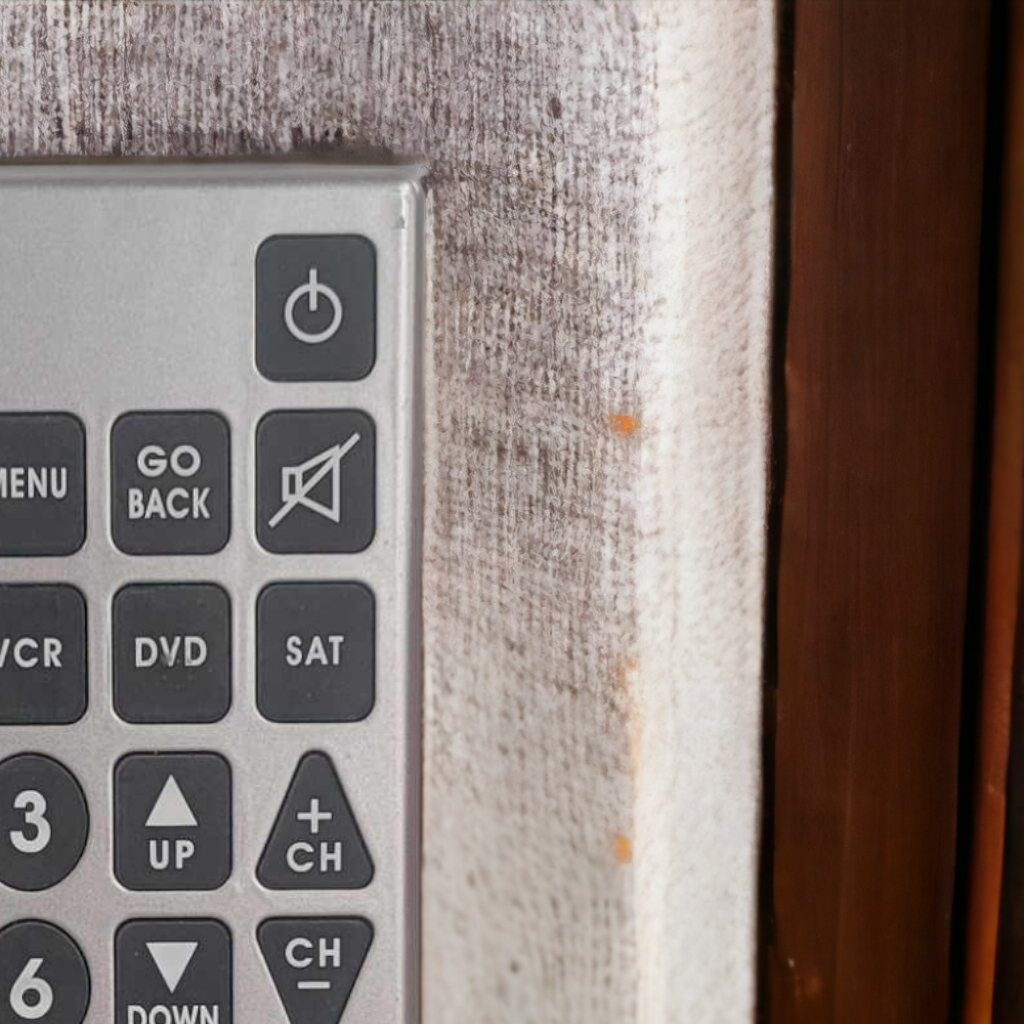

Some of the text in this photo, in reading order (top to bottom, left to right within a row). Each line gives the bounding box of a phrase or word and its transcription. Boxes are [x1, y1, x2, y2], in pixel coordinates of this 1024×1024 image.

[138, 446, 200, 476] GO
[129, 488, 209, 518] BACK
[136, 637, 206, 667] DVD
[287, 636, 343, 665] SAT
[11, 791, 50, 852] 3
[150, 840, 194, 869] UP
[287, 842, 341, 871] CH
[286, 938, 340, 967] CH
[10, 959, 52, 1019] 6
